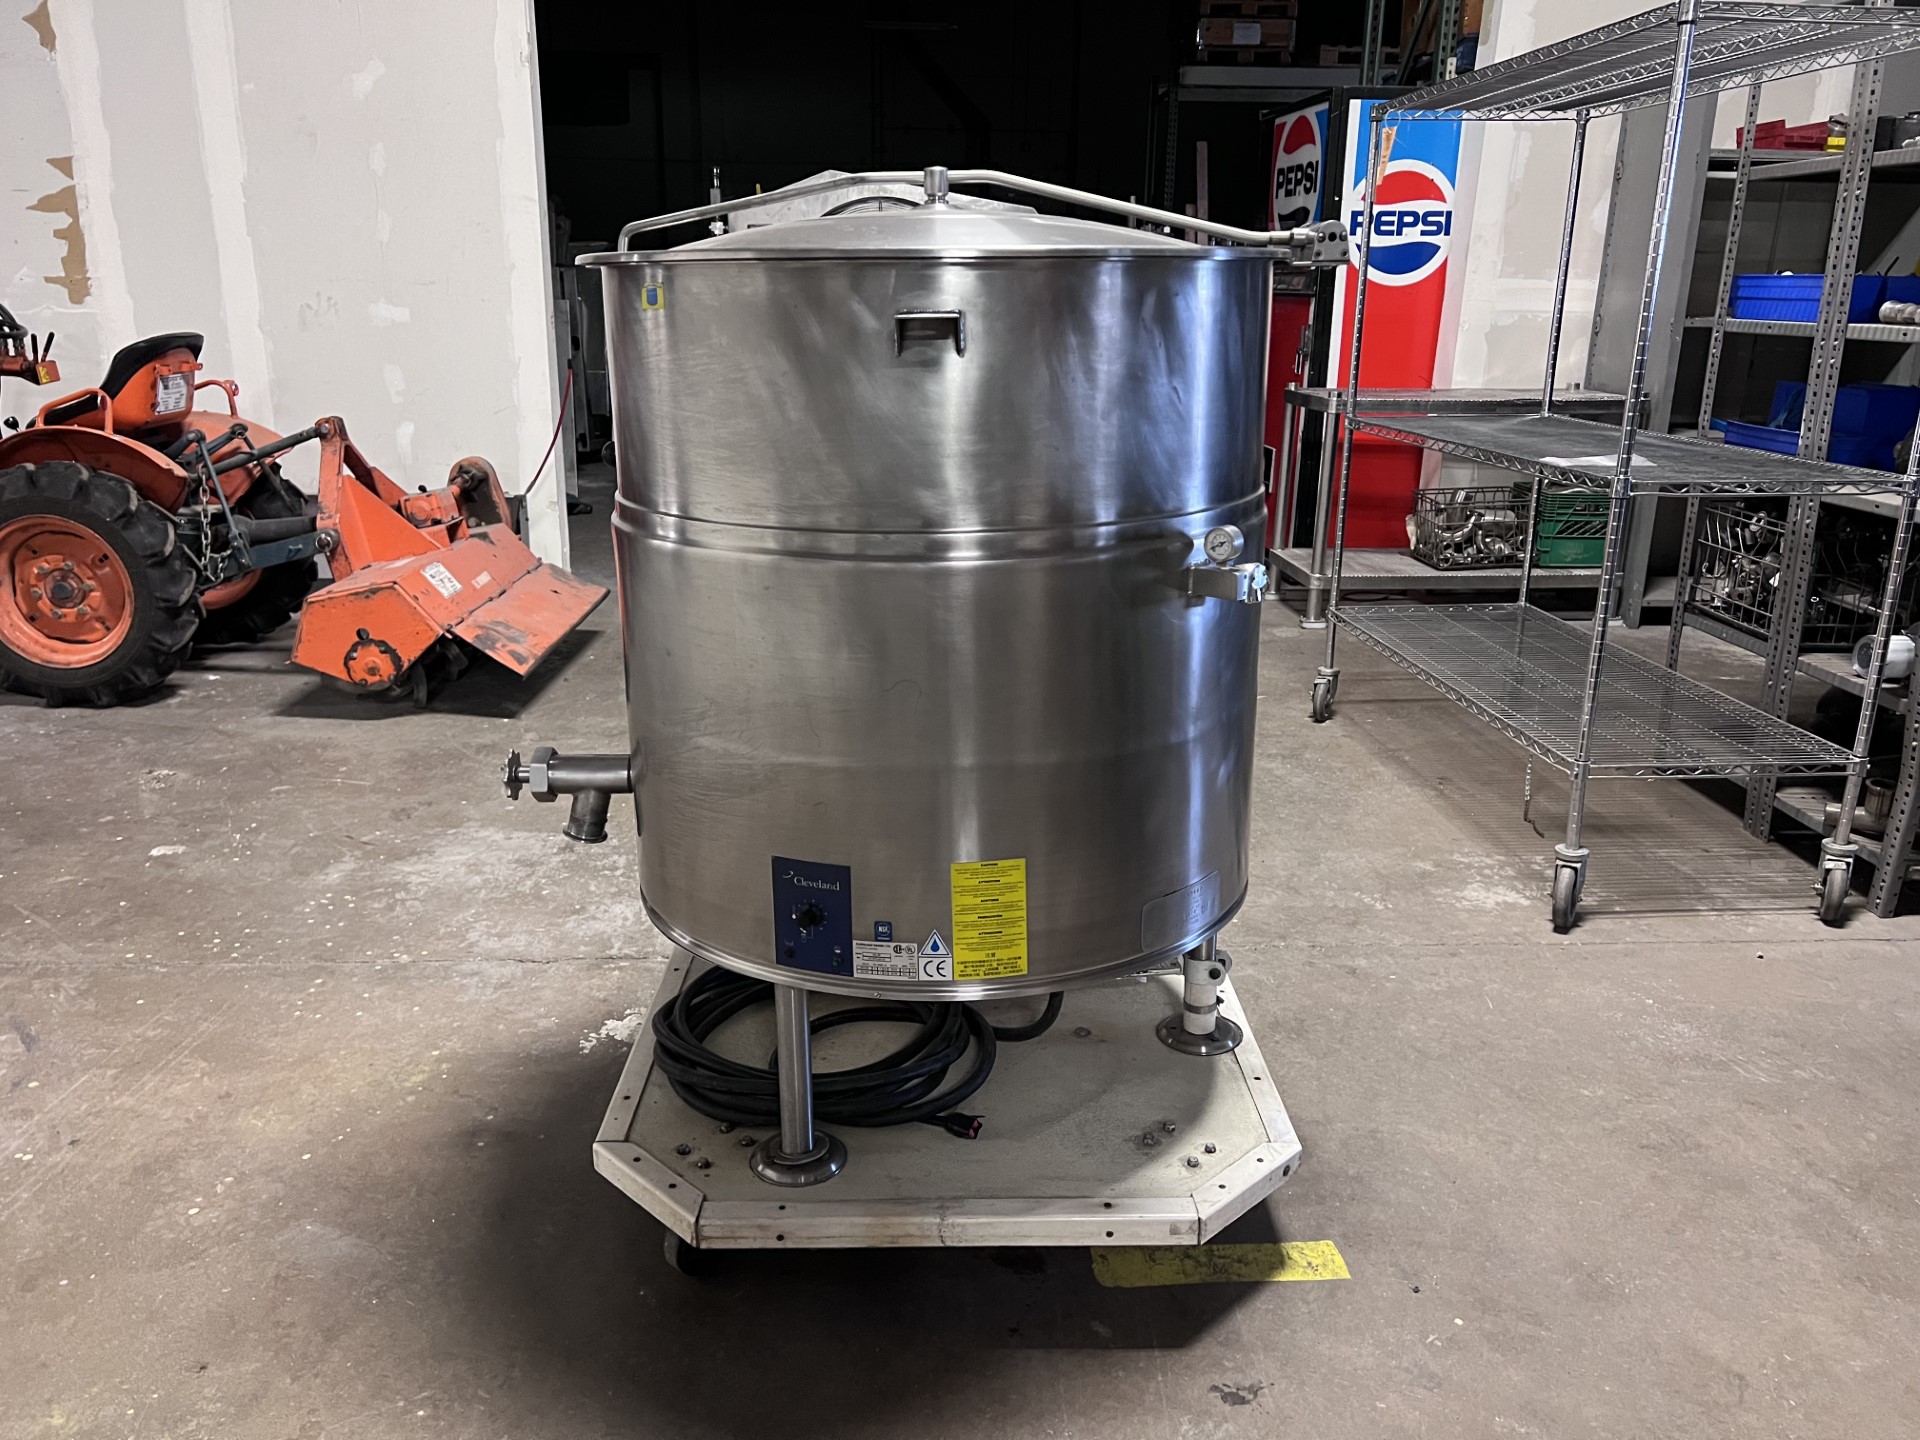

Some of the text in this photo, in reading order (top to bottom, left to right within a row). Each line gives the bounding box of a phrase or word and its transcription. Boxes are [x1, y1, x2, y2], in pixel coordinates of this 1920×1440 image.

[1275, 160, 1320, 200] PEPSI
[1349, 210, 1453, 237] PEPSI
[793, 876, 840, 891] Cleveland
[923, 960, 946, 978] CE
